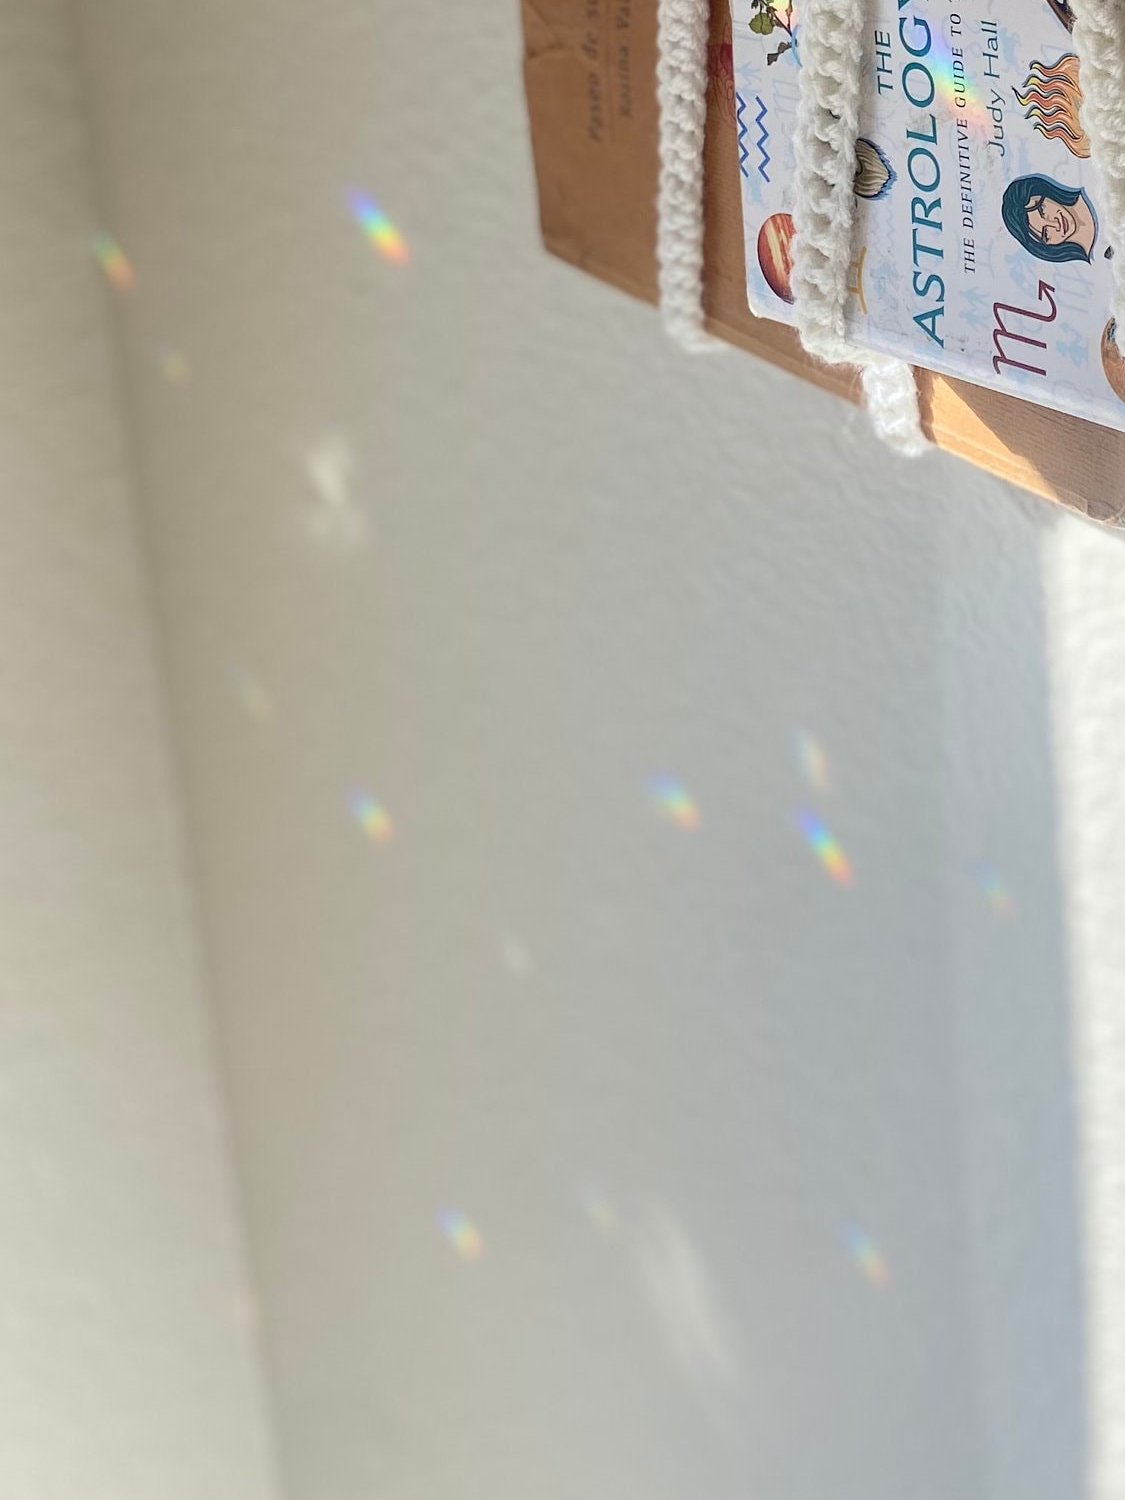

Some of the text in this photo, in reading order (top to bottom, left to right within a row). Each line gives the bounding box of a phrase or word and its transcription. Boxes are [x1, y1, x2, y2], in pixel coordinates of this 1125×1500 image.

[580, 32, 599, 61] de
[949, 13, 962, 37] TO
[874, 30, 893, 95] THE
[951, 47, 967, 108] GUIDE
[980, 20, 1006, 157] Judy Hall
[956, 118, 974, 229] DEFINITIVE
[963, 238, 976, 274] THE
